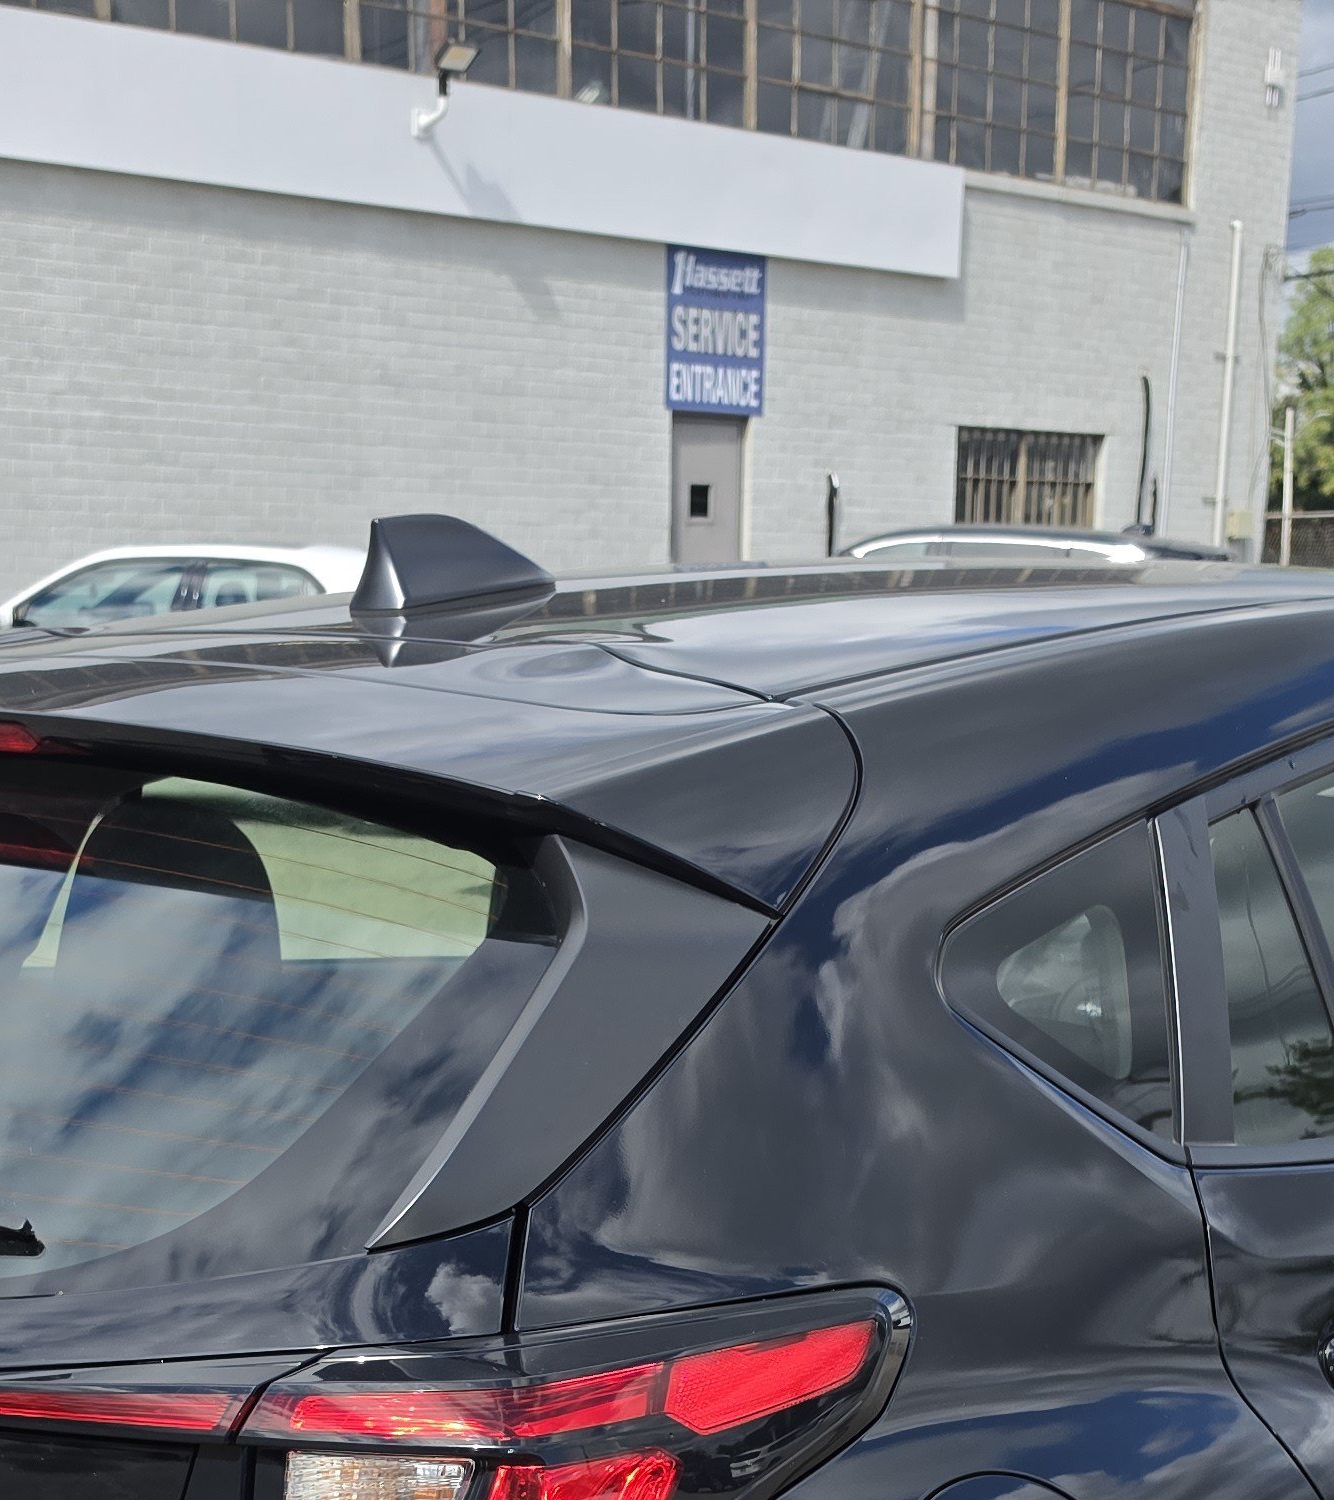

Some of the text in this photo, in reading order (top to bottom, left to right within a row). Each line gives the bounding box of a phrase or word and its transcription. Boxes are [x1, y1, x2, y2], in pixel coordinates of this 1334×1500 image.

[671, 250, 762, 295] Hassett
[671, 304, 760, 358] SERVICE
[669, 361, 760, 408] ENTRANCE
